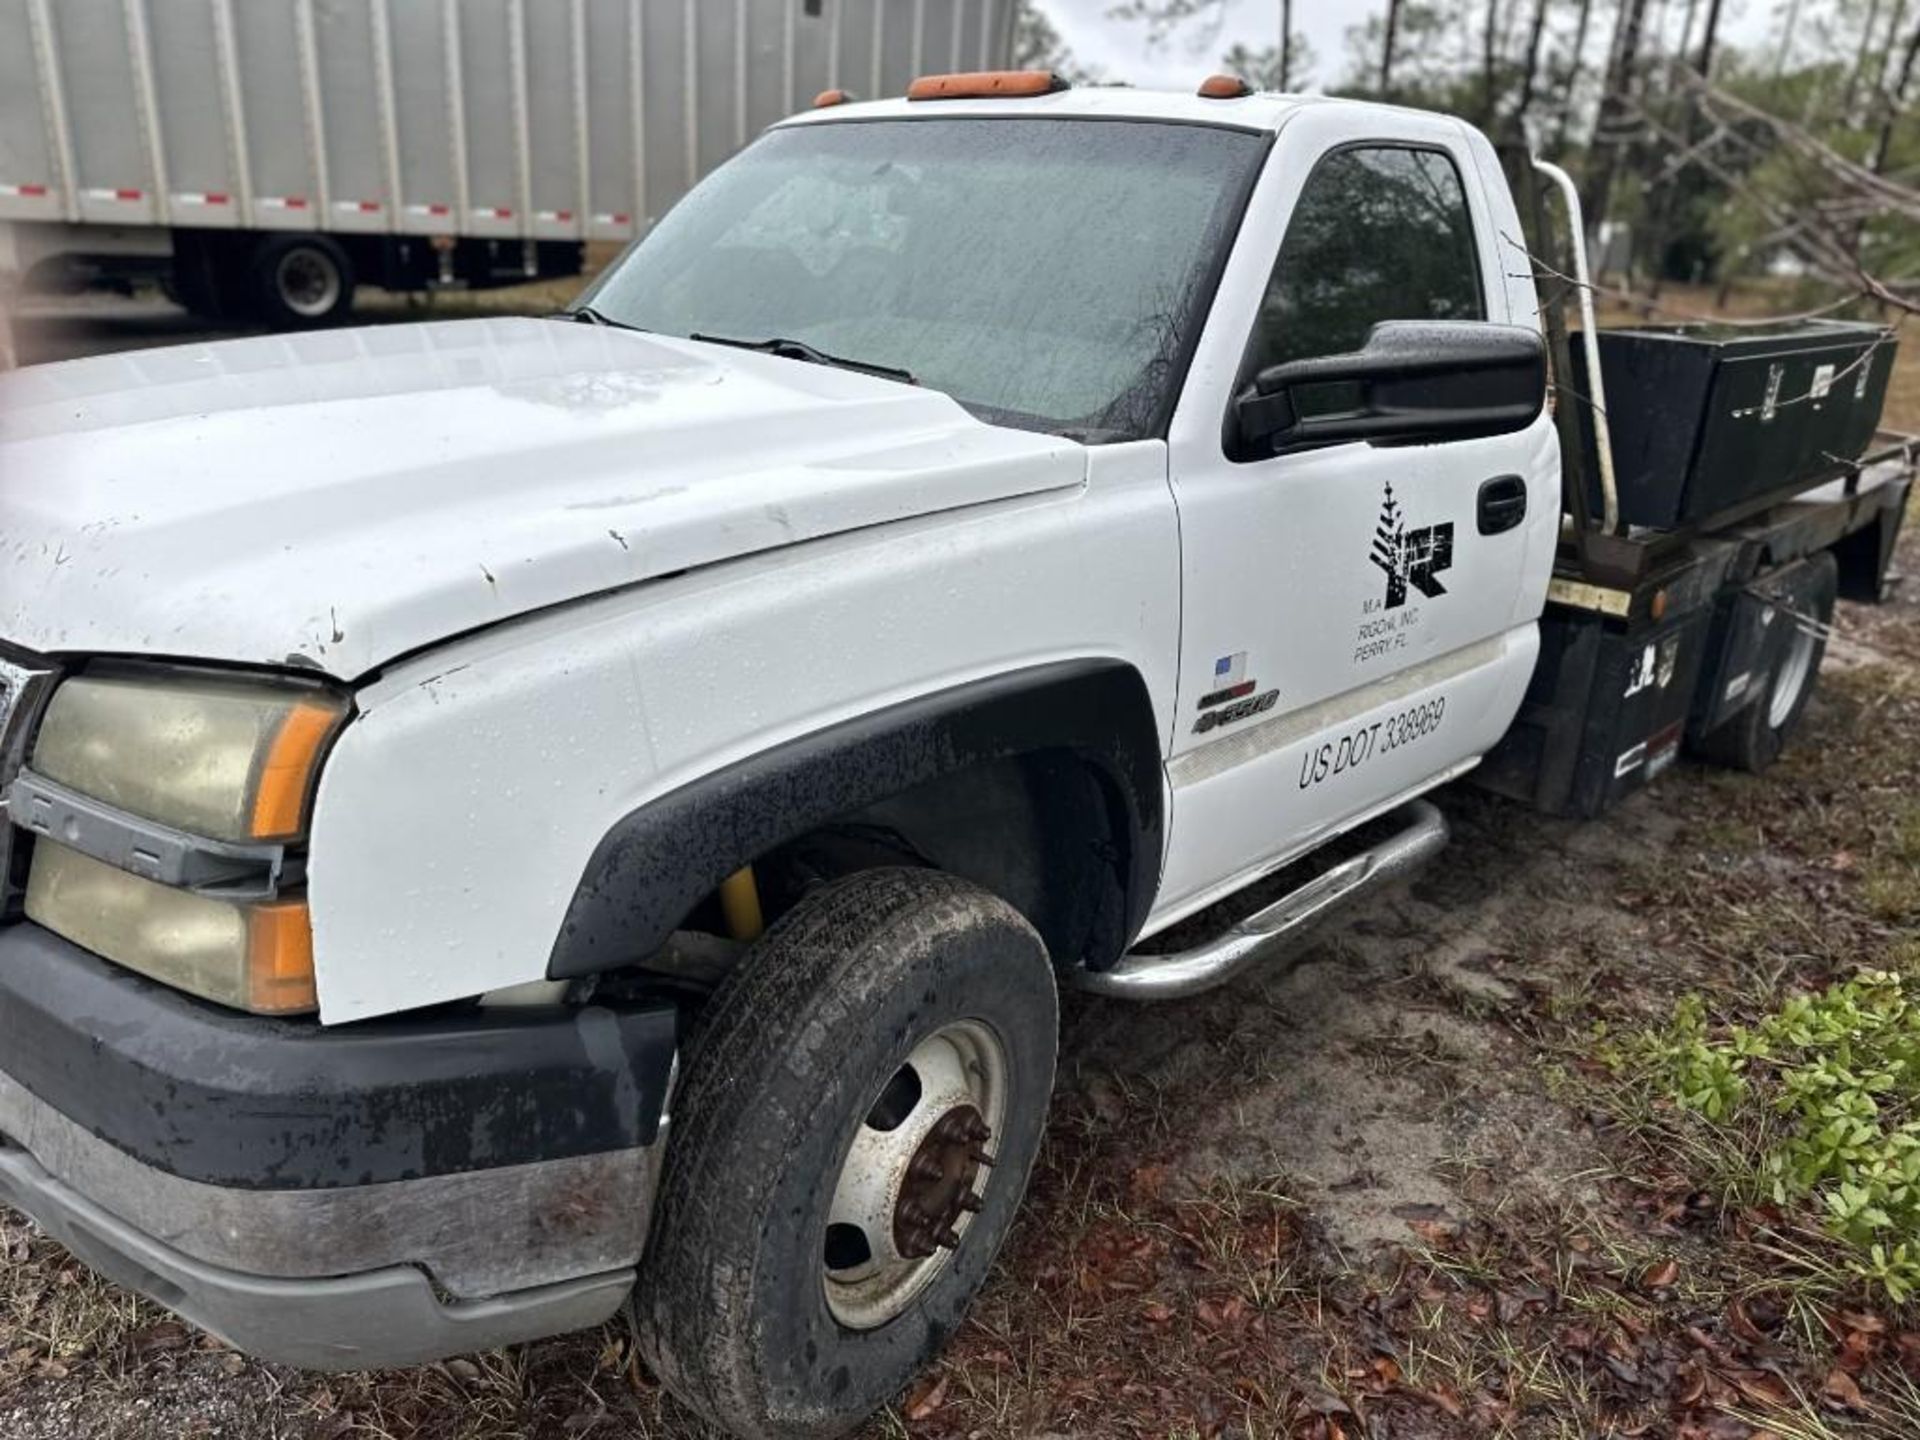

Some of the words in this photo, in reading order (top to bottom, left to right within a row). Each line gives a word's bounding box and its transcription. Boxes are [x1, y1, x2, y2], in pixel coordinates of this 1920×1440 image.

[1299, 743, 1333, 790] US
[1333, 722, 1383, 775] DOT
[1381, 695, 1446, 753] 338969
